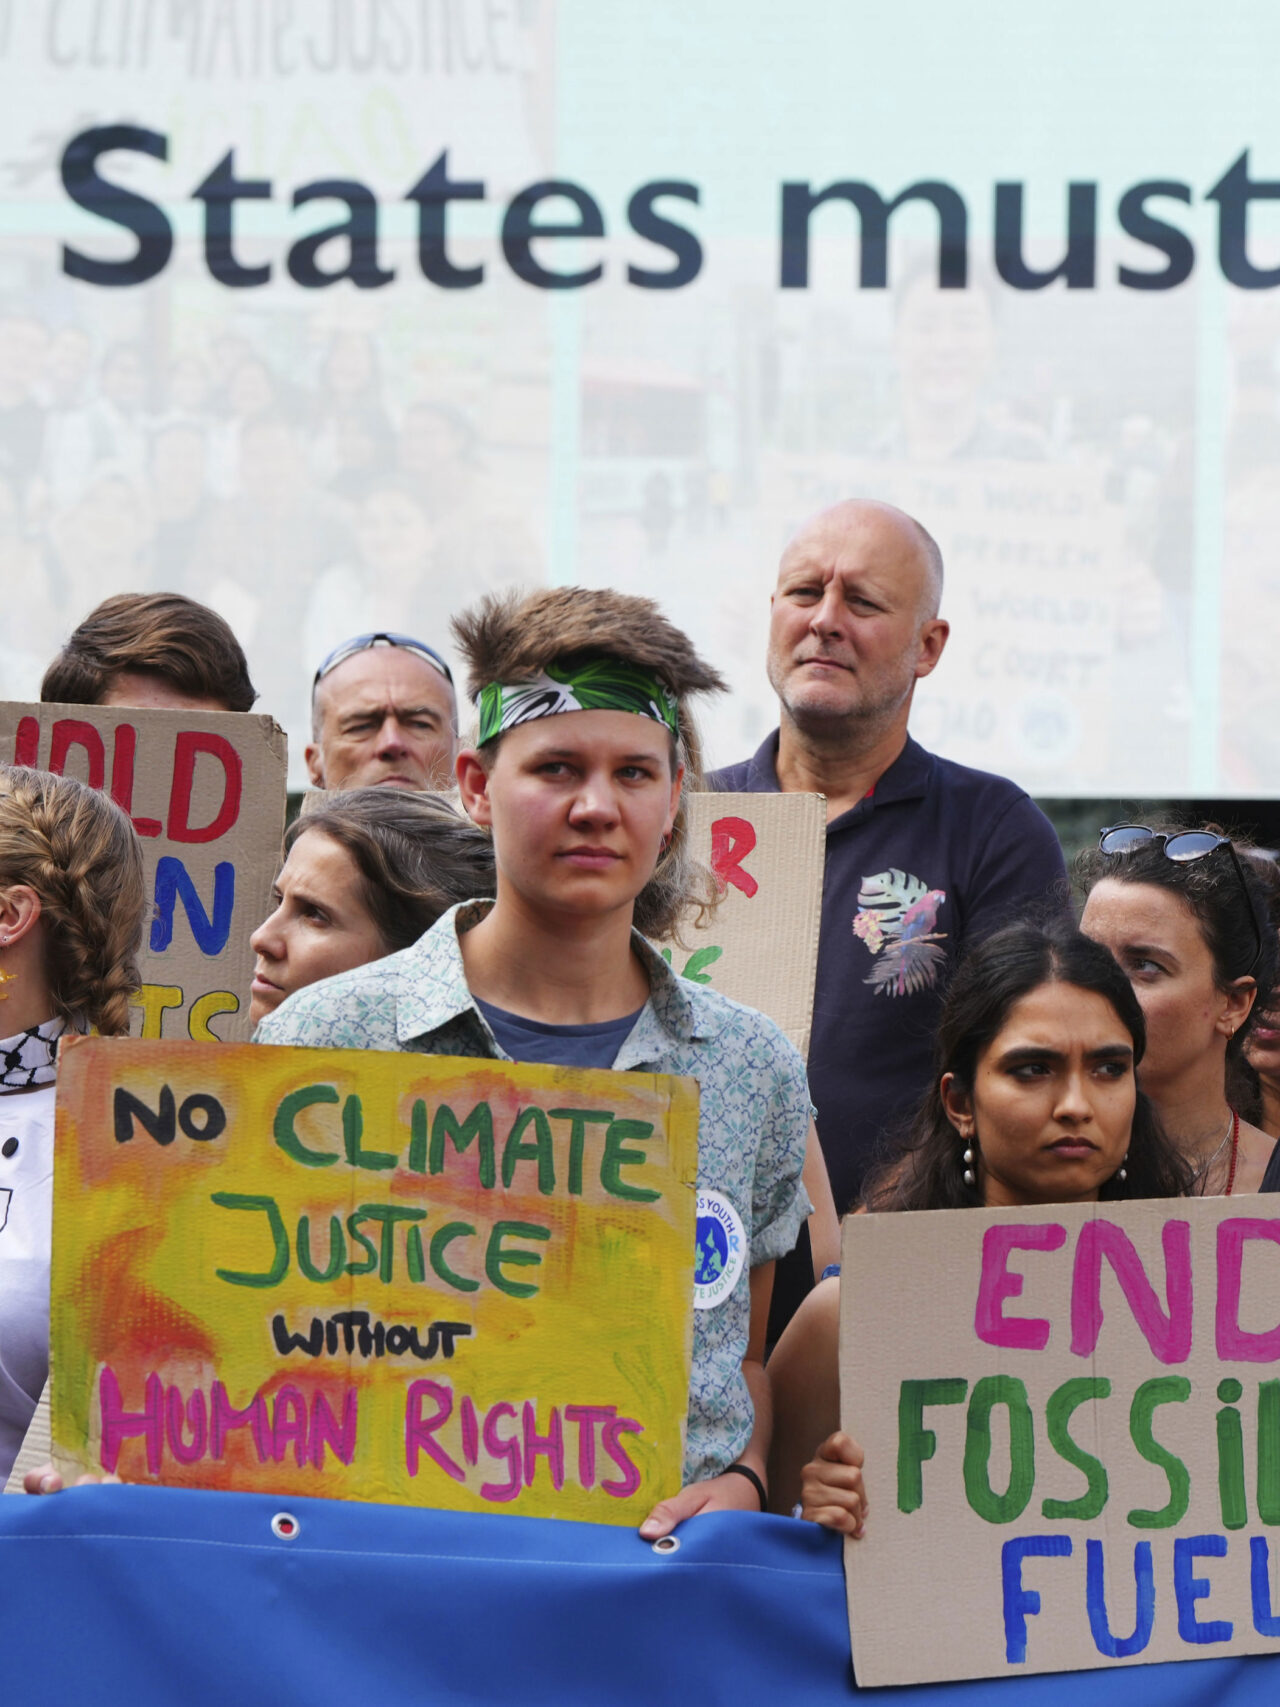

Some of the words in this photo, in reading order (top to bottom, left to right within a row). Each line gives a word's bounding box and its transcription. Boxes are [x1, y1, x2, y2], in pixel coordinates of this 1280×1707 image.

[58, 121, 705, 292] States
[113, 1084, 227, 1146] NO
[273, 1084, 662, 1203] CLIMATE
[210, 1191, 552, 1299] JUSTICE
[706, 1199, 736, 1233] YOUTH
[707, 1256, 737, 1299] JUSTICE
[272, 1310, 473, 1360] WITHOUT
[98, 1364, 358, 1477] HUMAN
